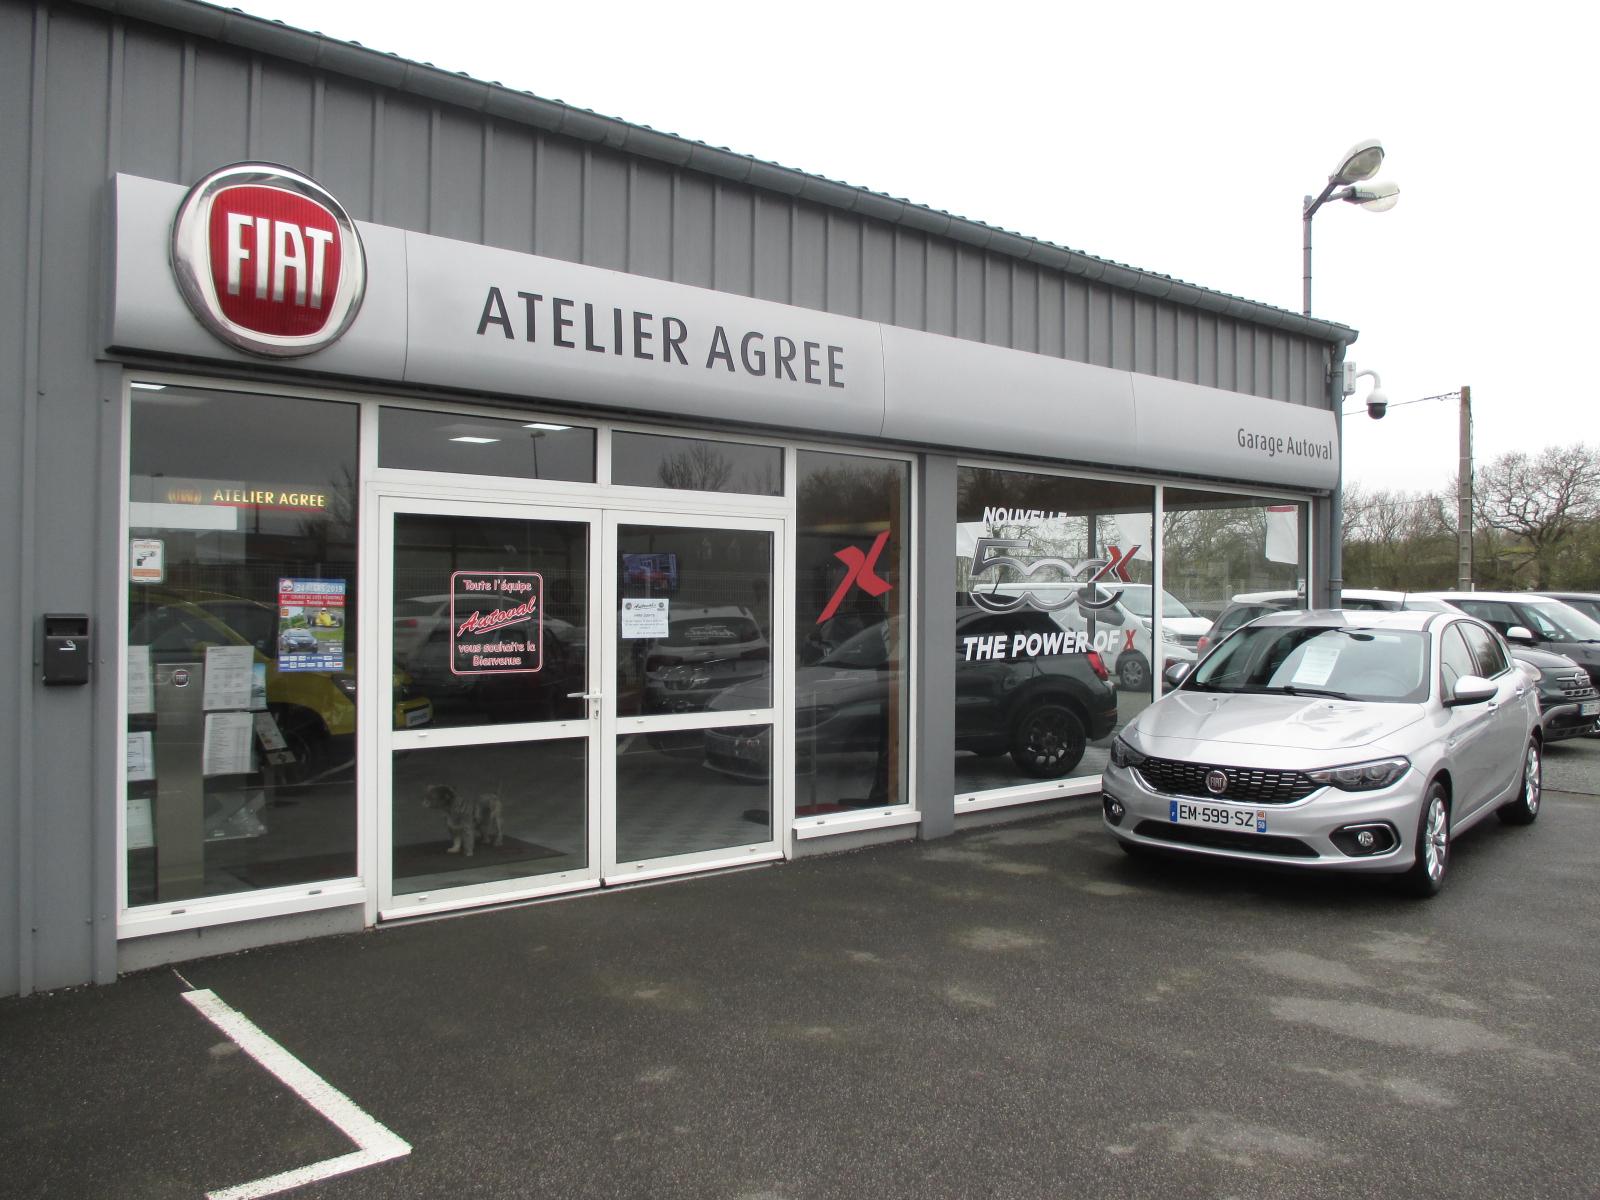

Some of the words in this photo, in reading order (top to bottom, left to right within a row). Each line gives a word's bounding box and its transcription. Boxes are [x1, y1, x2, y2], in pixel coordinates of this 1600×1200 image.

[227, 212, 333, 310] FIAT
[476, 286, 689, 366] ATELIER
[705, 325, 845, 389] AGREE
[1237, 428, 1283, 457] Garage
[1286, 436, 1332, 460] Autoval
[213, 488, 274, 504] ATELIER
[279, 493, 325, 507] AGREE
[462, 579, 492, 591] Toute
[493, 579, 532, 594] l'équipe
[456, 595, 536, 637] Autoval
[458, 643, 482, 653] vous
[483, 641, 525, 653] souhaite
[527, 640, 536, 652] la
[963, 634, 1008, 661] THE
[1011, 631, 1089, 658] POWER
[1093, 629, 1121, 653] OF
[1123, 629, 1137, 650] X
[472, 655, 522, 666] Bienvenue
[1179, 804, 1254, 827] EM-599-SZ
